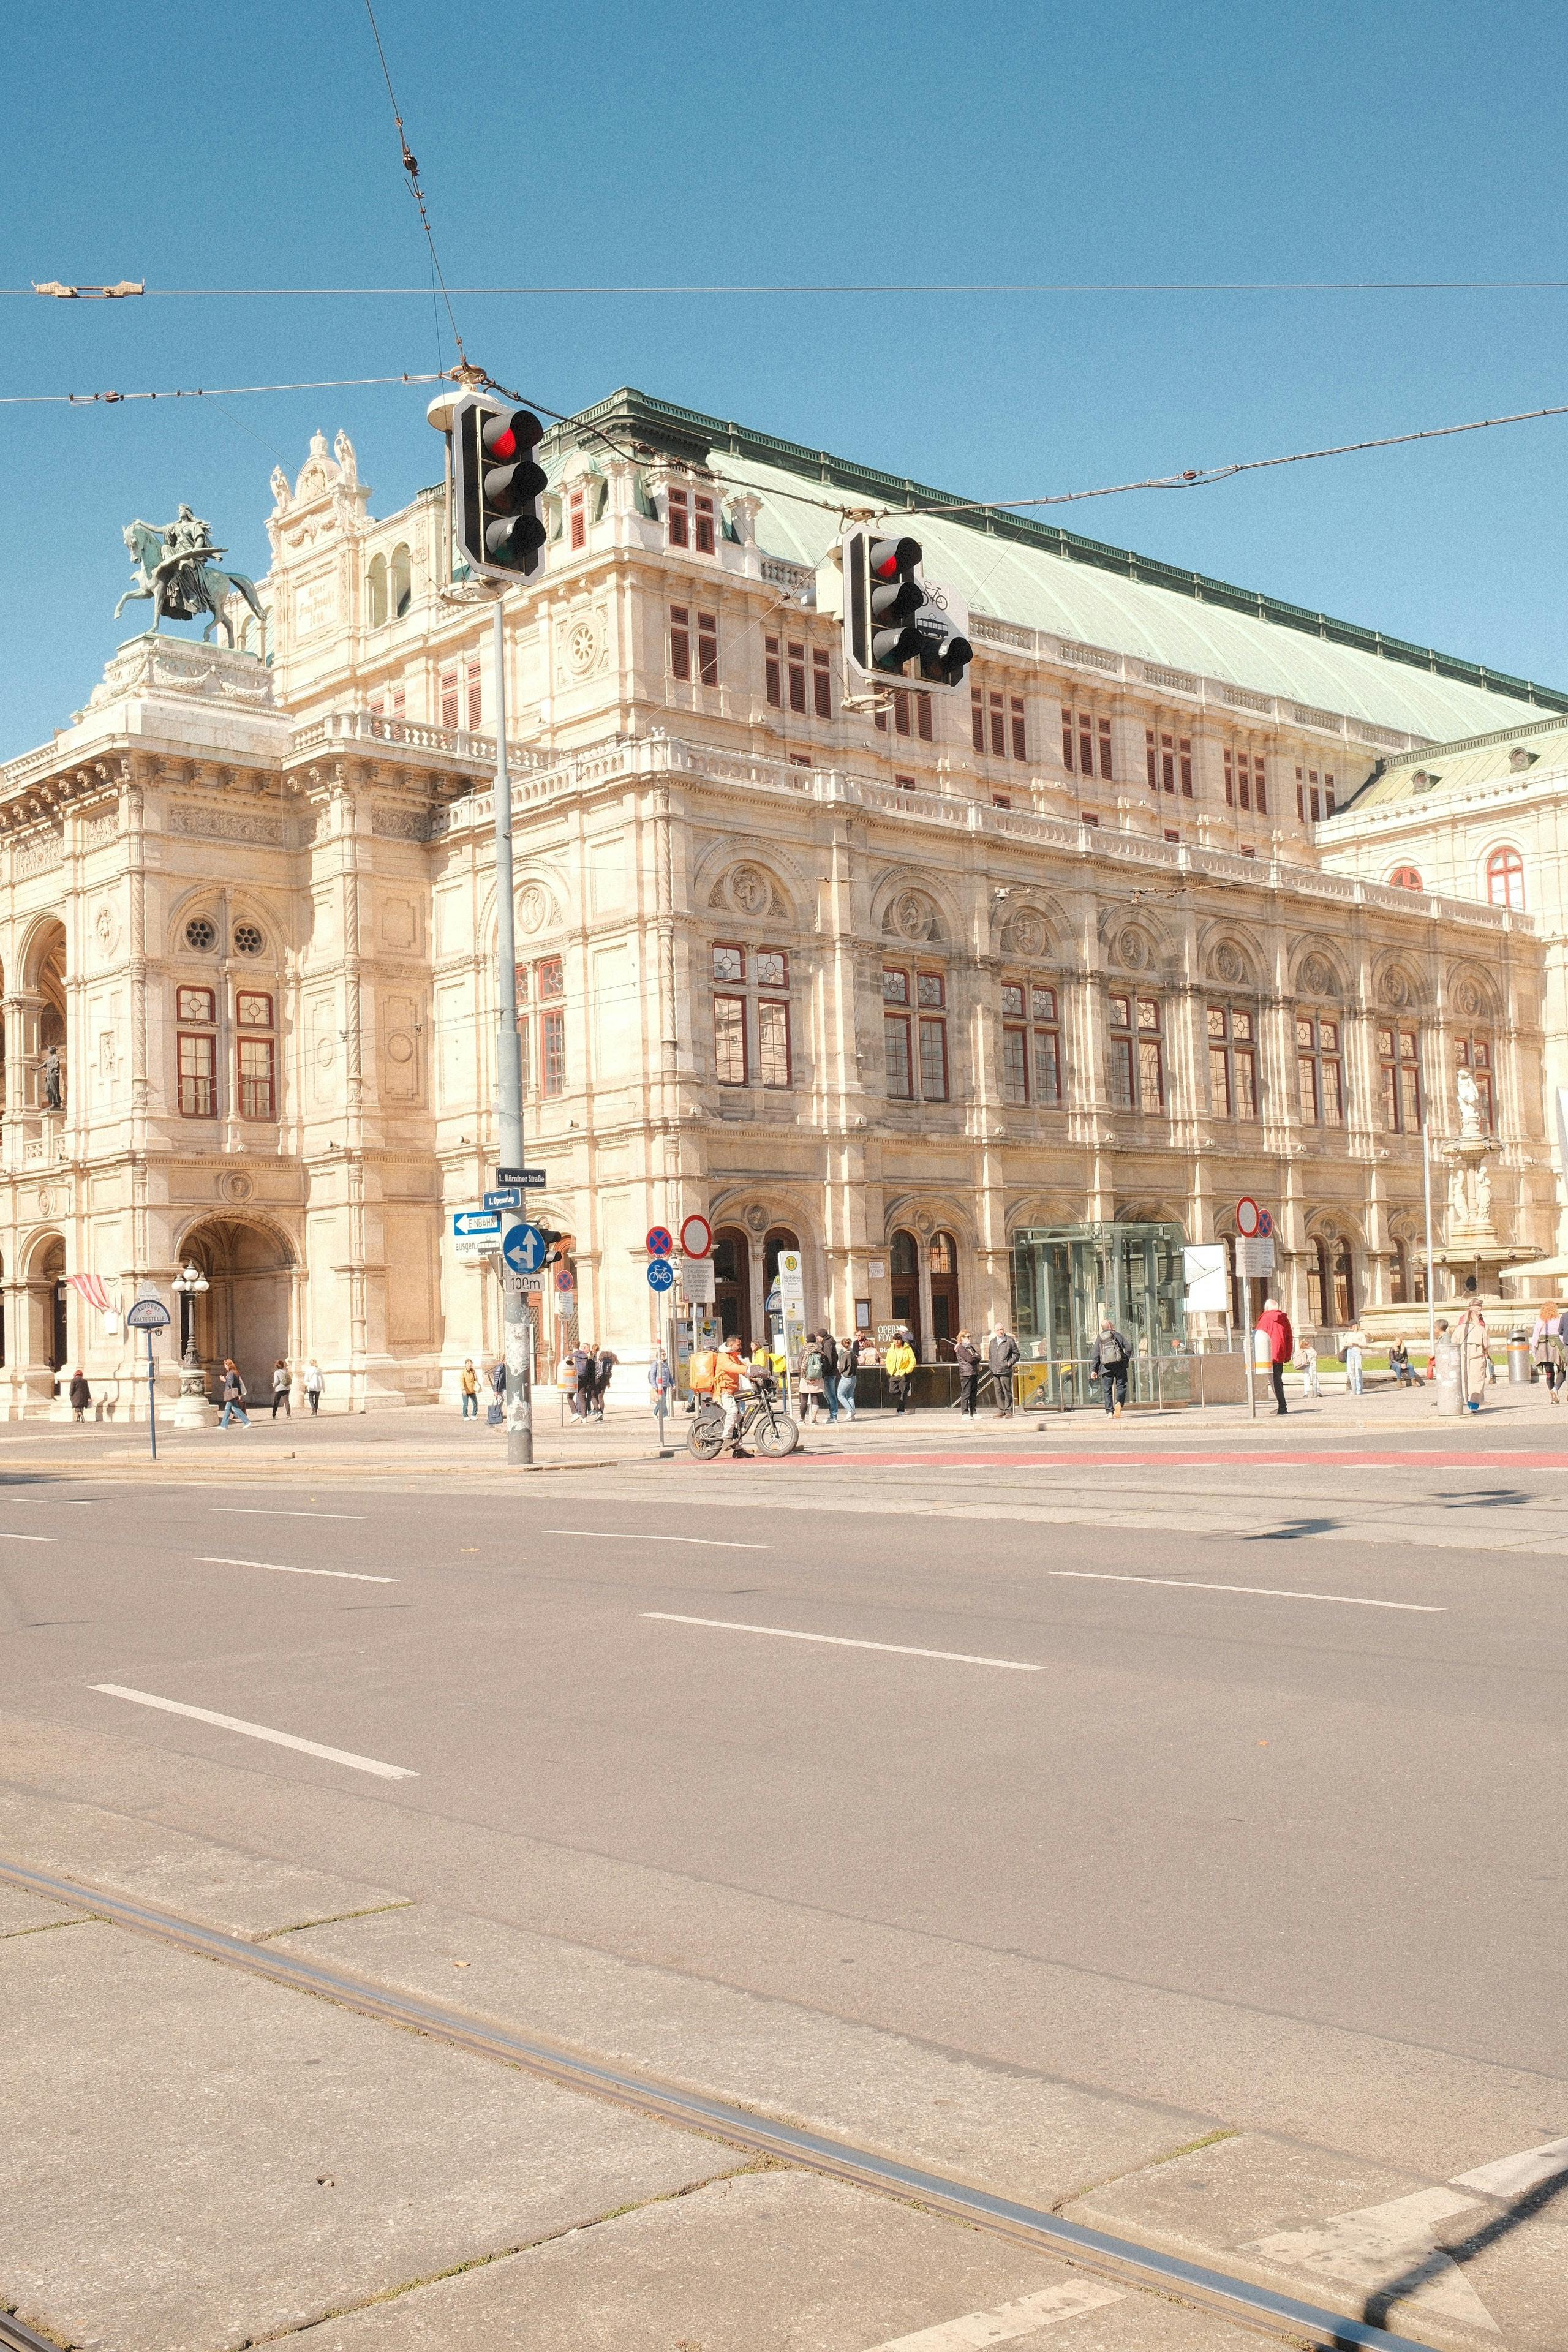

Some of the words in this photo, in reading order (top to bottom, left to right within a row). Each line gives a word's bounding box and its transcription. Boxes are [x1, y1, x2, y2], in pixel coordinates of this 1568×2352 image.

[505, 1174, 528, 1182] Kärntner
[493, 1196, 514, 1206] Opernring
[468, 1216, 496, 1229] EINBAHN
[455, 1240, 477, 1253] ausgen.
[137, 1303, 161, 1312] AUTOBUS
[878, 1333, 894, 1342] FOY
